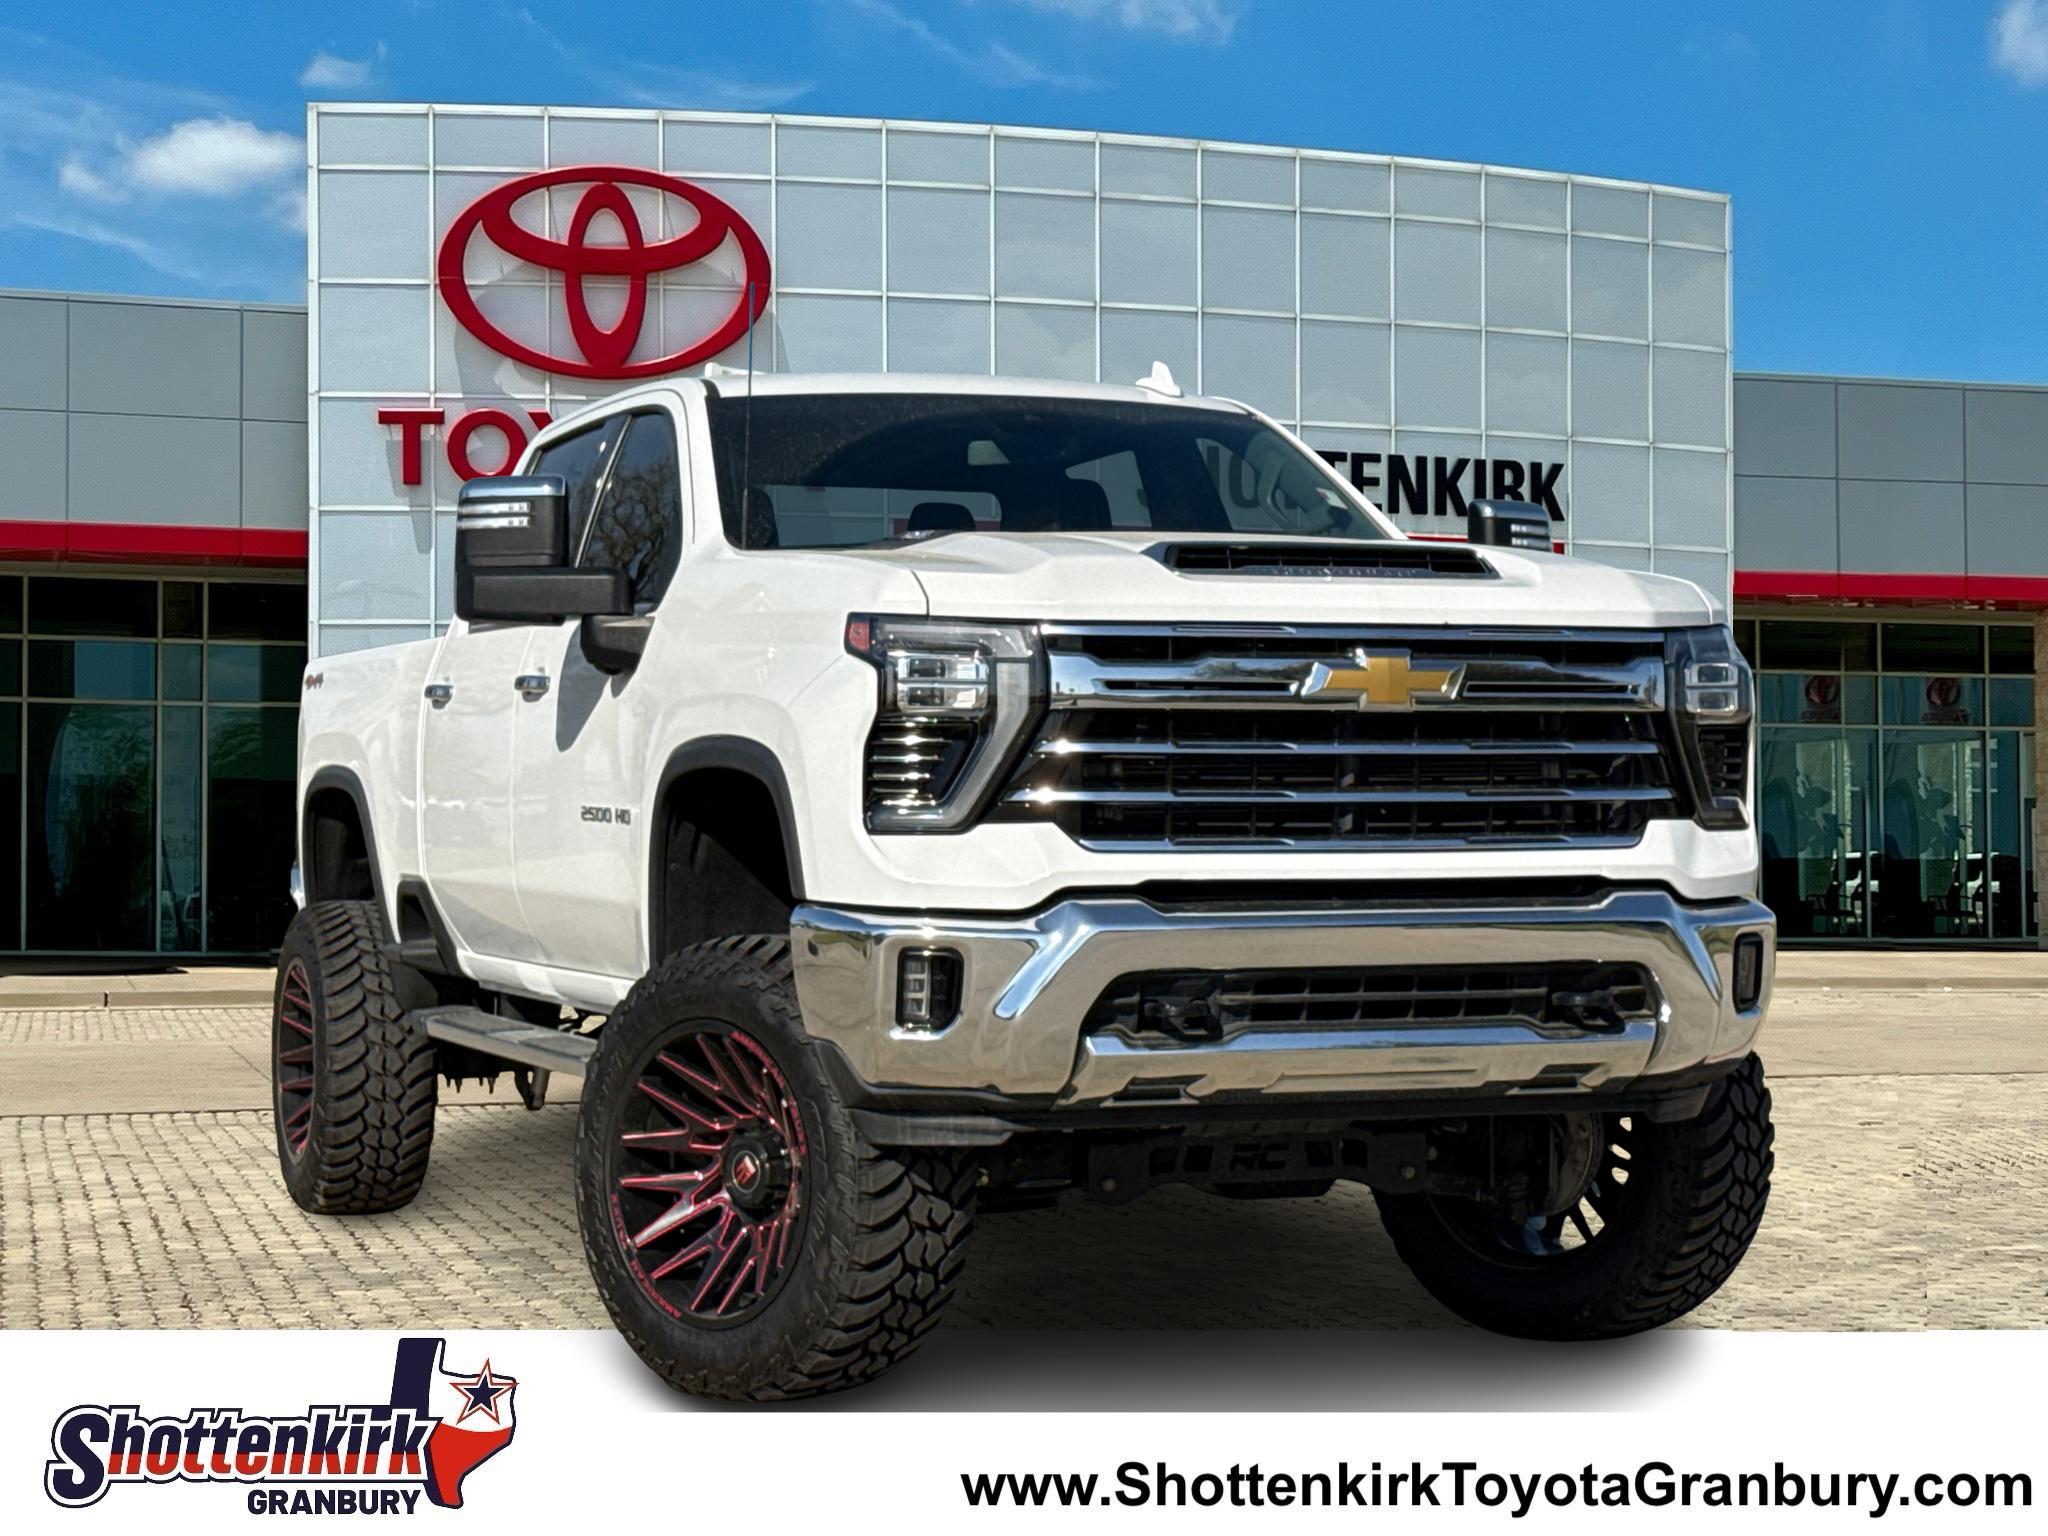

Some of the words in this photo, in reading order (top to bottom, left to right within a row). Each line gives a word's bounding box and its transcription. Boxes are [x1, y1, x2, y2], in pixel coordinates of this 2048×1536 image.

[378, 407, 553, 486] TO
[581, 806, 612, 823] 2500
[615, 807, 631, 825] HD
